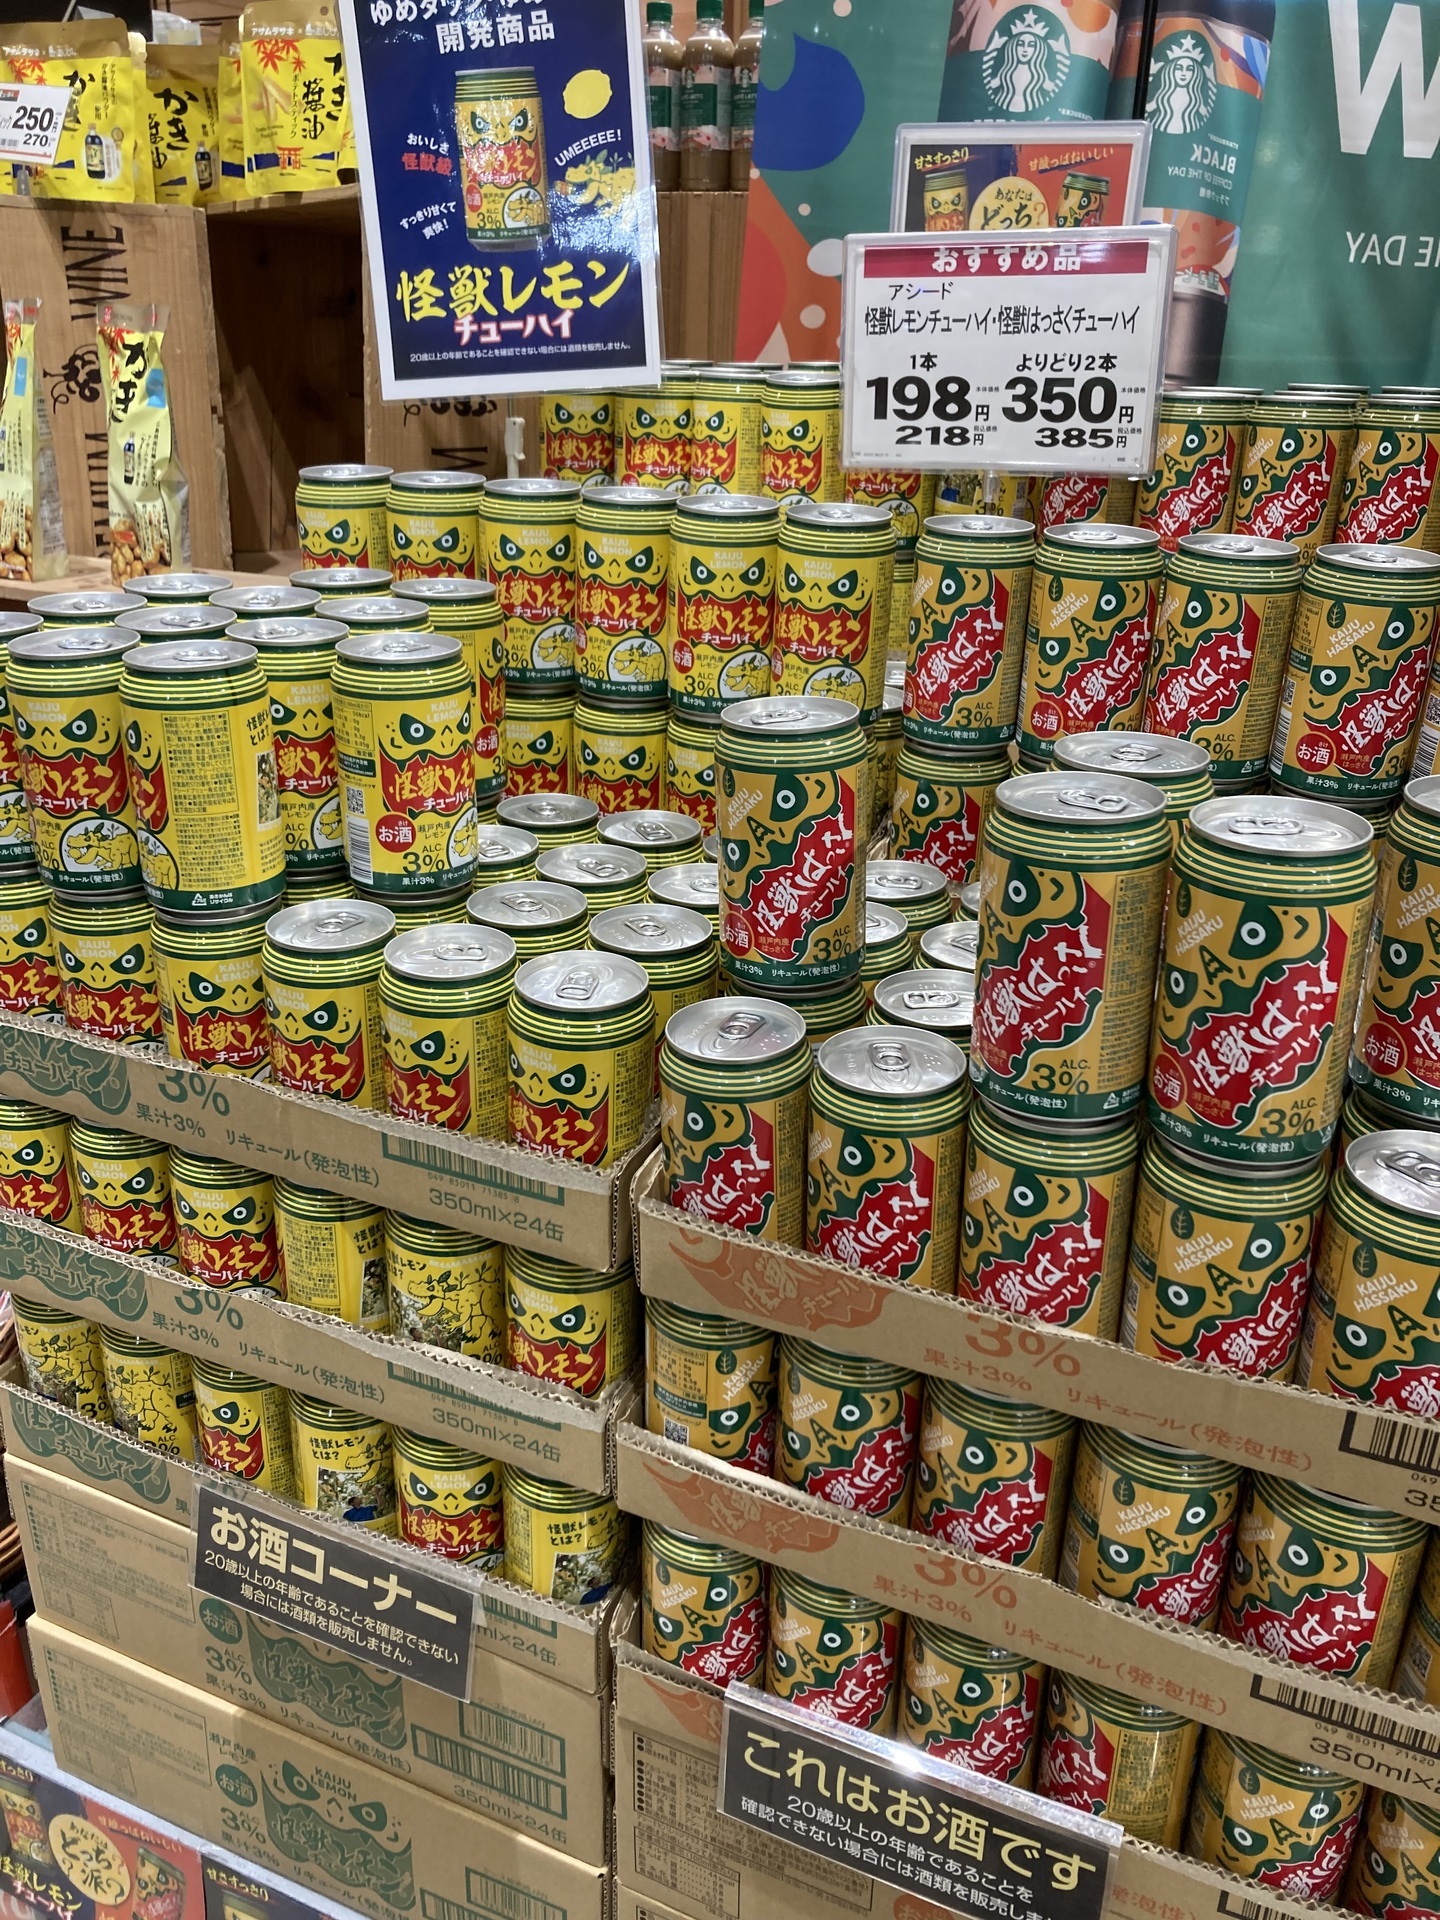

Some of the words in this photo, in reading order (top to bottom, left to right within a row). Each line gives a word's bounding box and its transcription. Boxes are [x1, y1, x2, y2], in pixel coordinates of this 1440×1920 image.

[436, 9, 555, 54] 開発商品
[12, 105, 54, 132] 250
[153, 87, 199, 151] かき
[290, 73, 301, 140] ポテトスティック
[23, 133, 48, 147] 270
[407, 132, 449, 155] おいしさ
[914, 147, 970, 170] 甘さすっきり
[994, 187, 1033, 201] あなたは
[399, 201, 457, 230] すっきり甘くて
[931, 243, 1081, 272] おすすめ品
[396, 260, 629, 322] 怪獣レモン
[888, 281, 954, 301] アシード
[454, 308, 574, 346] チューハイ
[864, 303, 1140, 336] 怪獣レモンチューハイ・怪獣はっさくチューハイ
[910, 352, 938, 372] 1本
[1016, 352, 1118, 373] よりどり2本
[866, 376, 971, 421] 198
[975, 404, 990, 422] 円
[1001, 376, 1118, 424] 350
[1119, 405, 1135, 423] 円
[895, 426, 971, 446] 218
[973, 433, 984, 446] 円
[1034, 428, 1114, 448] 385
[1116, 435, 1127, 448] 円
[518, 537, 554, 547] LEMON
[521, 528, 550, 538] KAIJU
[601, 537, 629, 547] KAIJU
[598, 546, 633, 556] LEMON
[714, 550, 743, 560] KAIJU
[710, 559, 747, 571] LEMON
[799, 568, 836, 581] LEMON
[803, 559, 833, 571] KAIJU
[513, 606, 560, 618] チューハイ
[592, 615, 638, 630] チューハイ
[701, 631, 752, 645] チューハイ
[1326, 621, 1376, 658] HASSAKU
[1329, 619, 1360, 644] KAIJU
[672, 649, 693, 668] お酒
[790, 641, 839, 658] チューハイ
[684, 675, 716, 697] 3%
[430, 700, 459, 712] KAIJU
[955, 706, 993, 728] 3%
[1031, 710, 1059, 732] お酒
[1297, 743, 1330, 766] お酒
[1305, 775, 1340, 789] 果汁3%
[35, 794, 91, 811] チューハイ
[423, 788, 471, 811] チューハイ
[727, 788, 750, 813] KAIJU
[728, 790, 763, 830] HASSAKU
[378, 826, 413, 843] お酒
[424, 830, 447, 839] レモン
[402, 851, 445, 875] 3%
[402, 876, 435, 886] 果汁3%
[799, 866, 850, 924] チューハイ
[1399, 883, 1435, 912] KAIJU
[1174, 915, 1225, 957] HASSAKU
[1176, 908, 1207, 939] KAIJU
[724, 925, 750, 949] お酒
[812, 937, 851, 964] 3%
[735, 960, 763, 975] 果汁3%
[1020, 985, 1088, 1042] チューハイ
[81, 1021, 137, 1036] チューハイ
[1248, 1022, 1327, 1088] チューハイ
[1365, 1034, 1401, 1068] お酒
[1059, 1058, 1091, 1070] ALC.
[157, 1064, 231, 1117] 3%
[1031, 1063, 1090, 1095] 3%
[1153, 1070, 1181, 1102] お酒
[1372, 1078, 1411, 1103] 果汁3%
[1290, 1096, 1318, 1111] ALC.
[136, 1101, 207, 1139] 果汁3%
[1158, 1111, 1193, 1139] 果汁3%
[1260, 1107, 1316, 1139] 3%
[1202, 1132, 1296, 1154] リキュール(発泡性)
[226, 1127, 381, 1189] リキュール(発泡性)
[428, 1186, 565, 1244] 350ml×24缶
[1173, 1238, 1234, 1274] HASSAKU
[1175, 1232, 1214, 1261] KAIJU
[1353, 1279, 1418, 1312] HASSAKU
[1356, 1272, 1397, 1297] KAIJU
[152, 1311, 220, 1349] 果汁3%
[965, 1313, 1081, 1378] 3%
[238, 1341, 386, 1405] リキュール(発泡性)
[923, 1347, 1033, 1393] 果汁3%
[432, 1406, 561, 1464] 350ml×24缶
[1067, 1387, 1313, 1472] リキュール(発泡性)
[309, 1434, 366, 1452] 怪獣レモン
[429, 1480, 471, 1490] LEMON
[433, 1472, 467, 1482] KAIJU
[1410, 1472, 1438, 1486] 049
[547, 1510, 608, 1536] 怪獣レモン
[1115, 1506, 1171, 1535] HASSAKU
[1117, 1502, 1153, 1521] KAIJU
[425, 1541, 481, 1555] チューハイ
[210, 1505, 458, 1625] お酒コーナー
[204, 1549, 460, 1665] 20歳以上の年齢であることを確認できない
[873, 1574, 973, 1623] 果汁3%
[240, 1583, 413, 1667] 場合には酒類を販売しません。
[1003, 1619, 1228, 1716] リキュール(発泡性)
[1314, 1721, 1338, 1736] 049
[314, 1764, 352, 1790] KAIJU
[310, 1778, 358, 1803] LEMON
[453, 1784, 568, 1845] 350ml×24缶
[743, 1730, 1097, 1892] これはお酒です
[740, 1795, 1052, 1920] 確認できない場合には酒類を販売しま
[786, 1795, 1034, 1904] 20歳以上の年齢であることを
